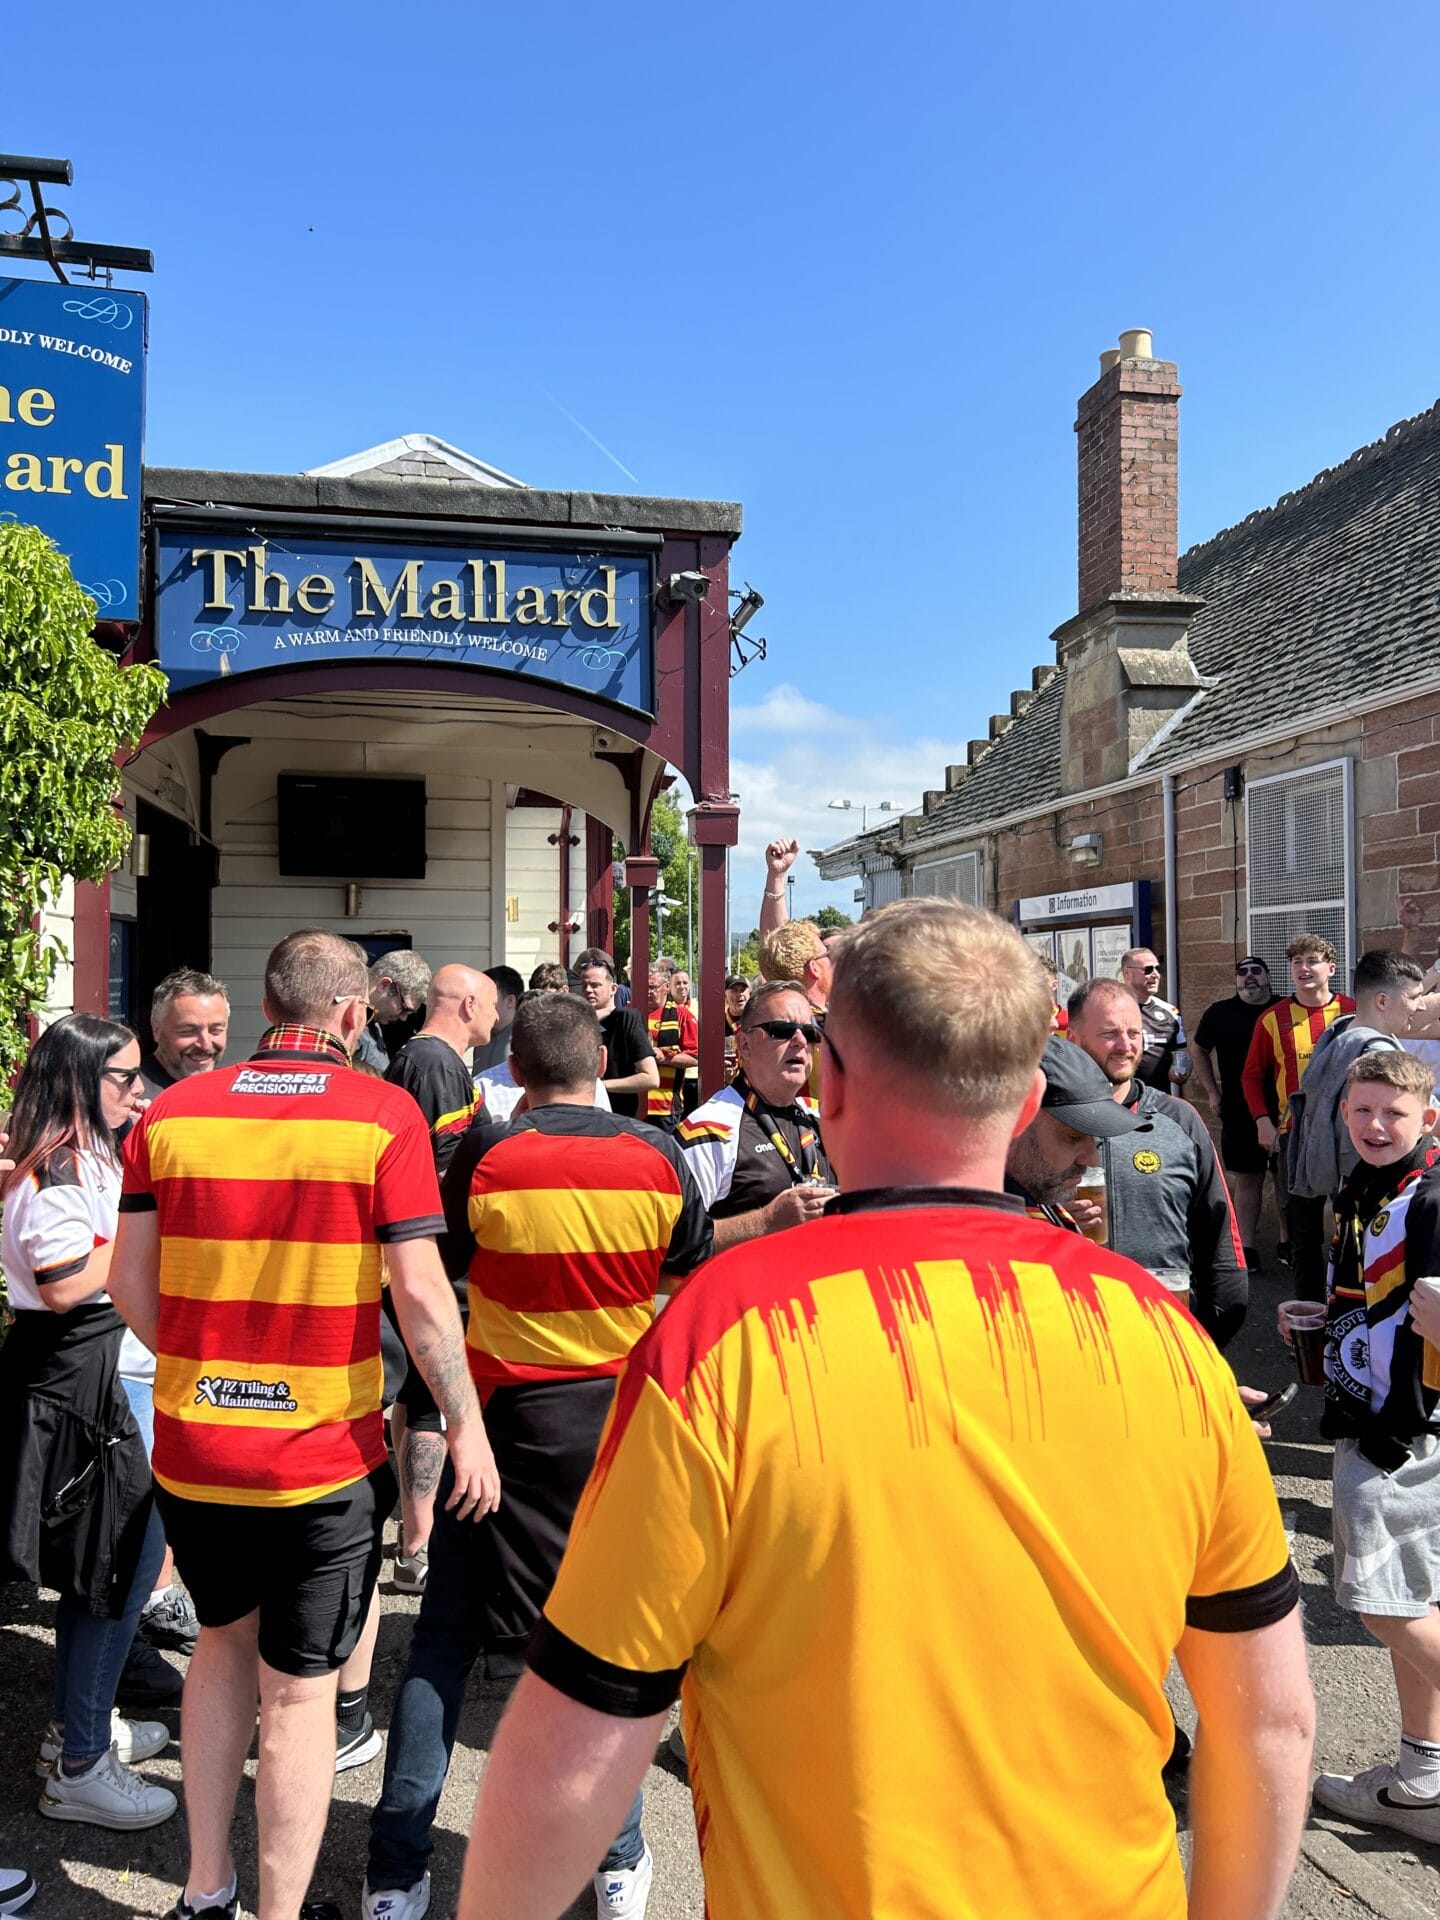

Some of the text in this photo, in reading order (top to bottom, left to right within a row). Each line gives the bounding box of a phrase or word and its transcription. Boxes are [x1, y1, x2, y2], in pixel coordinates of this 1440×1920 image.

[39, 334, 132, 375] WELCOME
[0, 443, 129, 500] ard
[191, 545, 621, 629] The Mallard
[274, 628, 548, 661] A WARM AND FRIENDLY WELCOME
[1057, 892, 1097, 910] Information
[235, 1070, 332, 1084] FORREST
[231, 1083, 326, 1094] PRECISION ENG
[222, 1380, 289, 1398] PZ Tiling &
[218, 1394, 296, 1410] Maintenance
